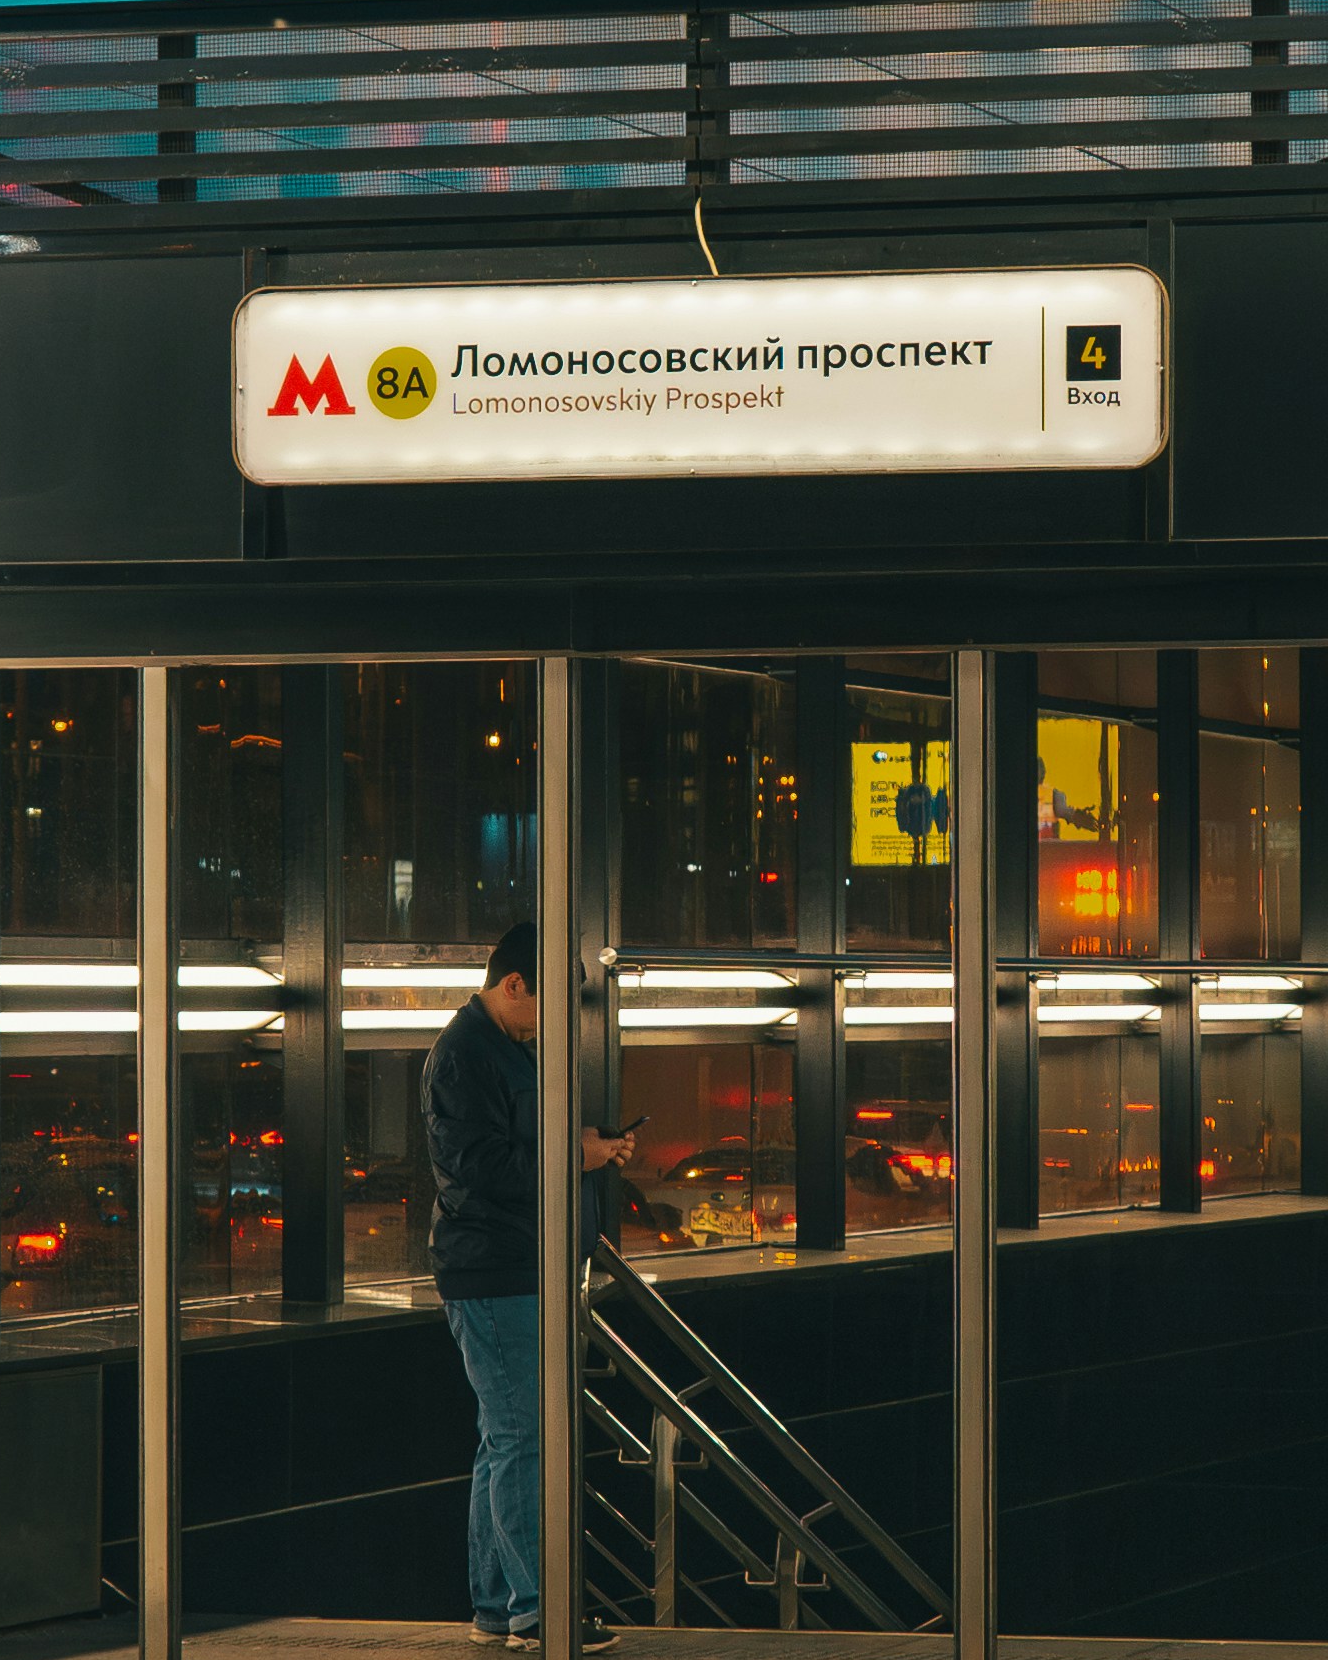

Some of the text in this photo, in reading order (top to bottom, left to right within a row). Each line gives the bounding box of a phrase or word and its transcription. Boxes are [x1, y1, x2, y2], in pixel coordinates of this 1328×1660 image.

[450, 336, 994, 378] Ломоносовский проспект
[1080, 336, 1107, 369] 4
[452, 383, 786, 417] Lomonosovskiy Prospekt
[1067, 387, 1121, 408] Вход
